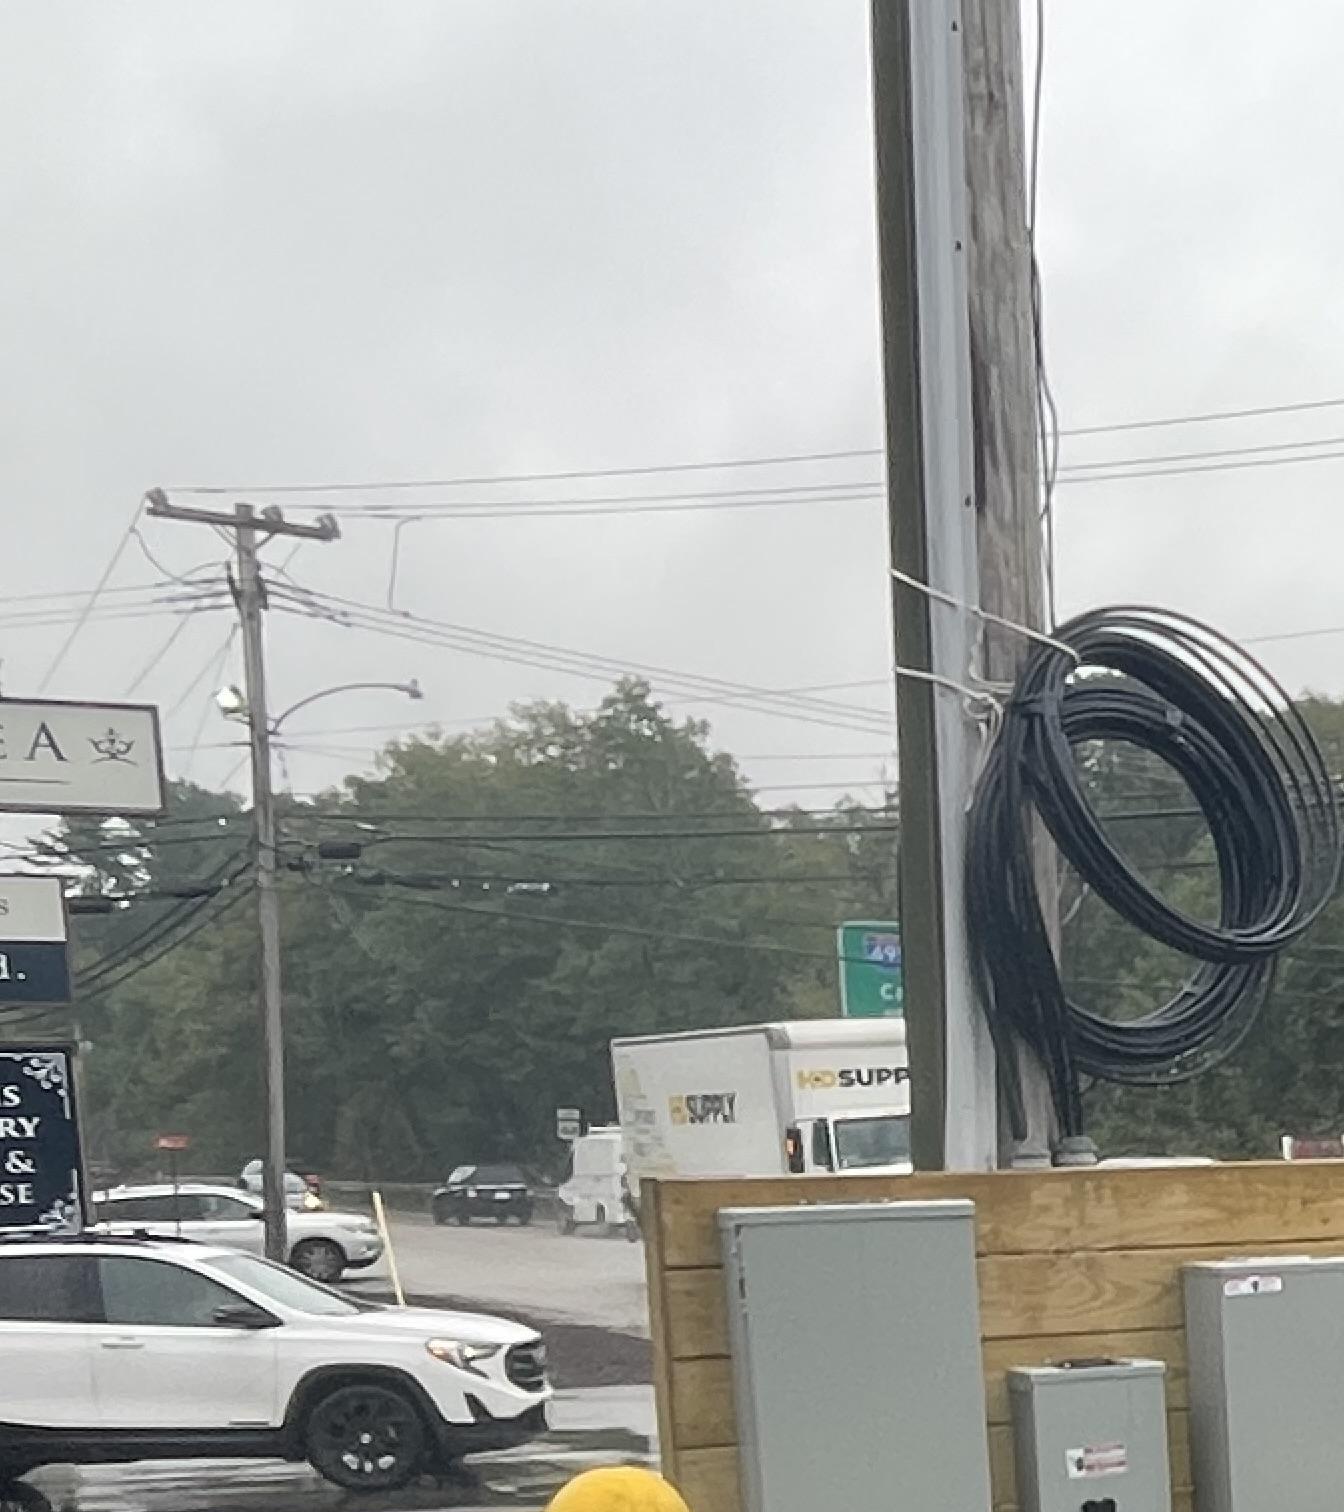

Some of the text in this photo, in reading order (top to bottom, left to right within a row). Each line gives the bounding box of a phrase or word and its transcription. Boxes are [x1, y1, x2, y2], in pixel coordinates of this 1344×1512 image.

[0, 721, 70, 761] A
[0, 1084, 22, 1108] S
[0, 1116, 41, 1138] RY
[4, 1150, 37, 1174] &
[0, 1183, 35, 1206] SE
